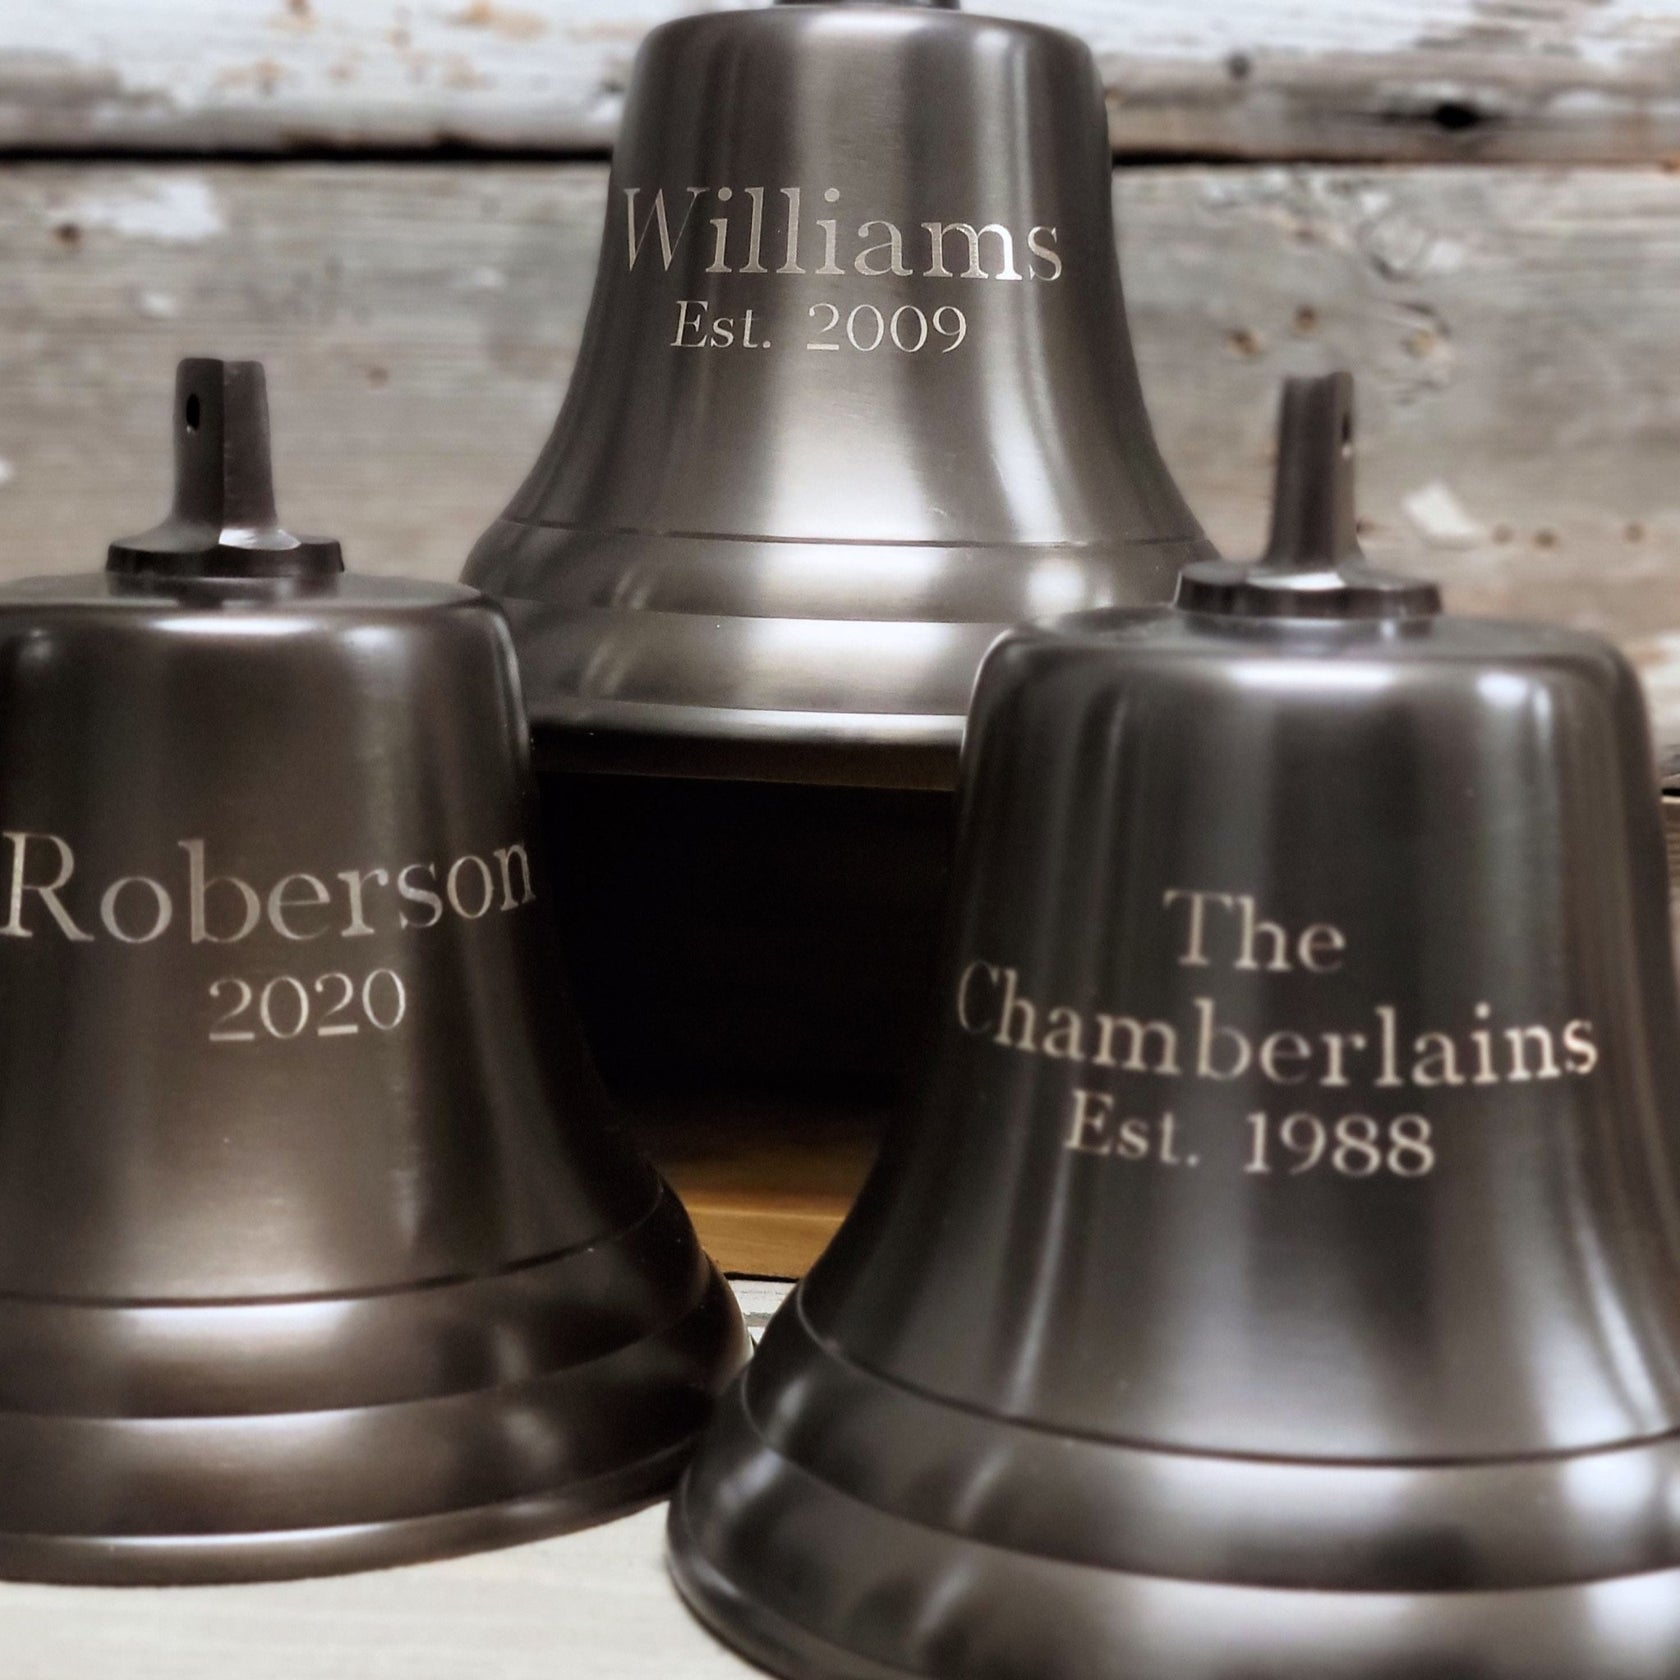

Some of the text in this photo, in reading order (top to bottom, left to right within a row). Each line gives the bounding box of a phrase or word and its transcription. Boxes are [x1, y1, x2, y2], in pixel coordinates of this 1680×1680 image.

[624, 187, 1063, 281] Williams
[671, 299, 969, 354] Est. 2009
[1, 831, 535, 944] Roberson
[1164, 888, 1346, 975] The
[208, 968, 407, 1042] 2020
[956, 961, 1599, 1087] Chamberlains
[1064, 1090, 1436, 1176] Est. 1988
